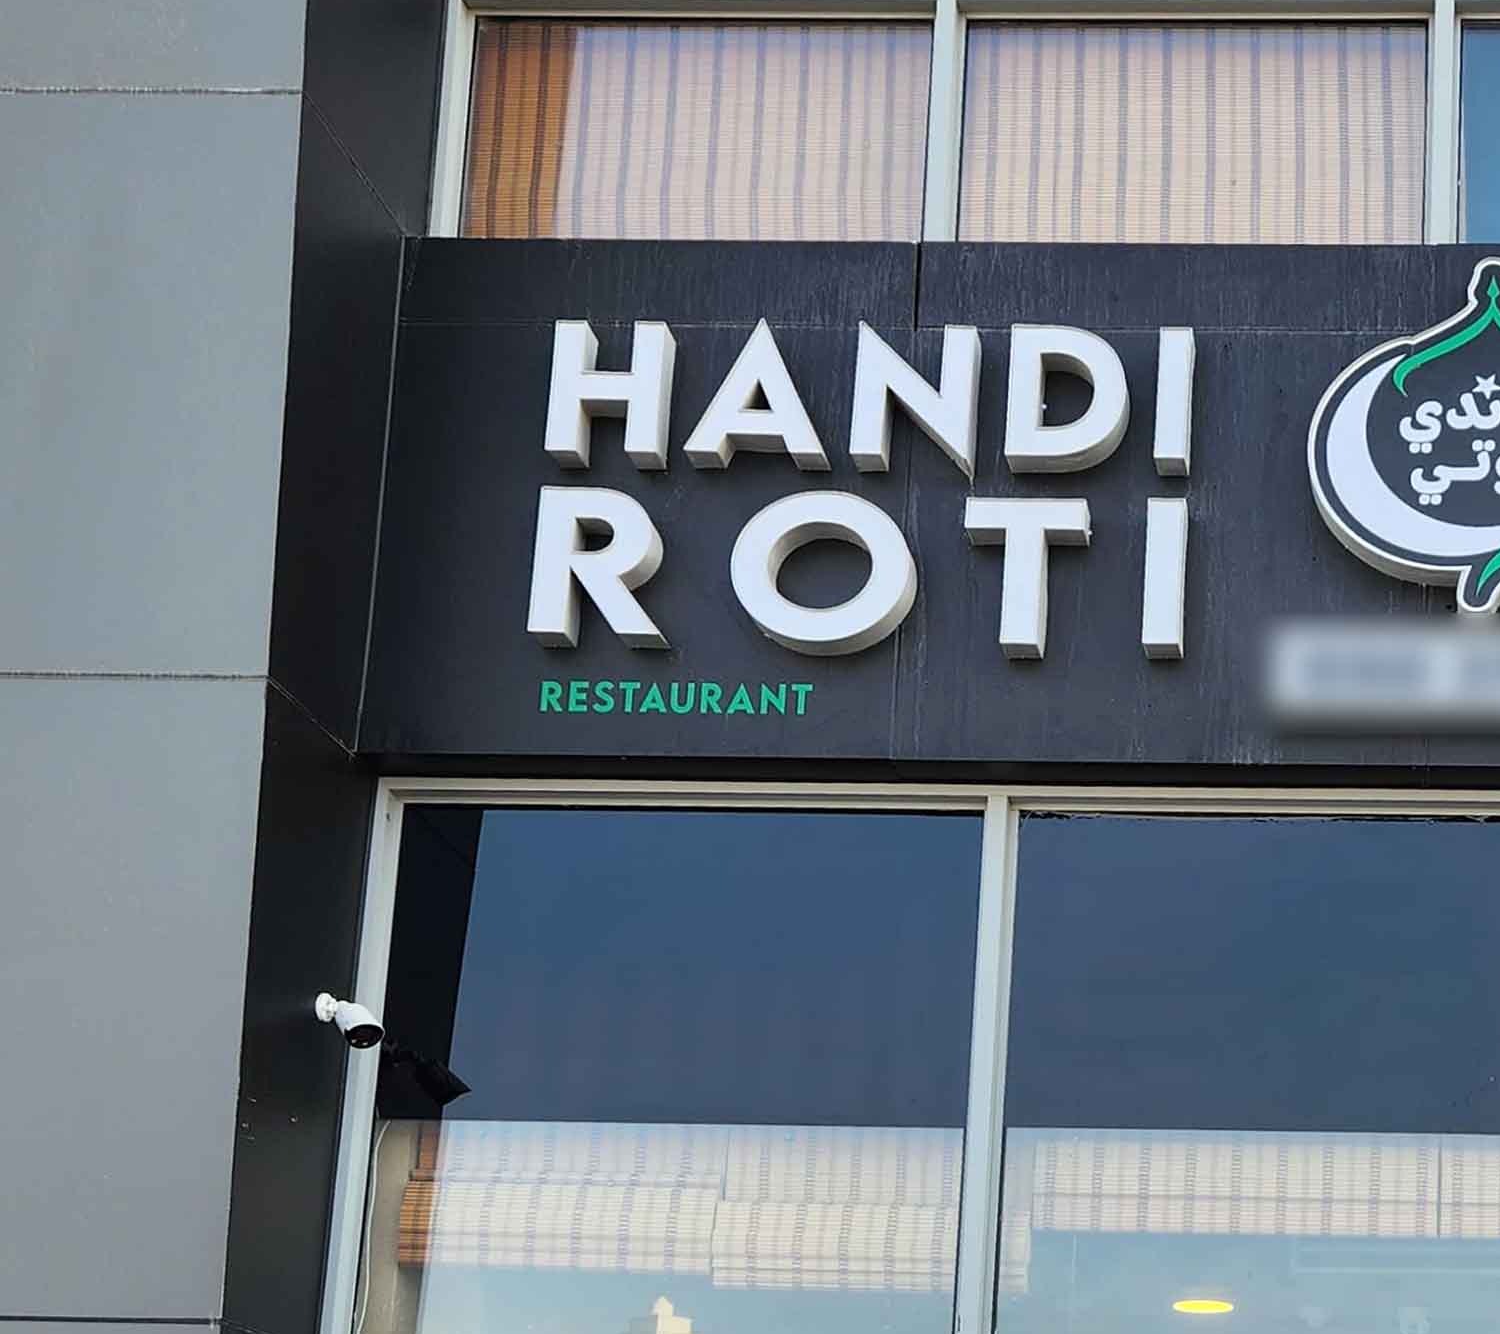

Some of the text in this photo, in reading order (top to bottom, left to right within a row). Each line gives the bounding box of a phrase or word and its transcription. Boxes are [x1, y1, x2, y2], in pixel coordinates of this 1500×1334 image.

[542, 318, 1196, 485] HANDI
[526, 485, 1190, 660] ROTI
[539, 680, 813, 717] RESTAURANT
